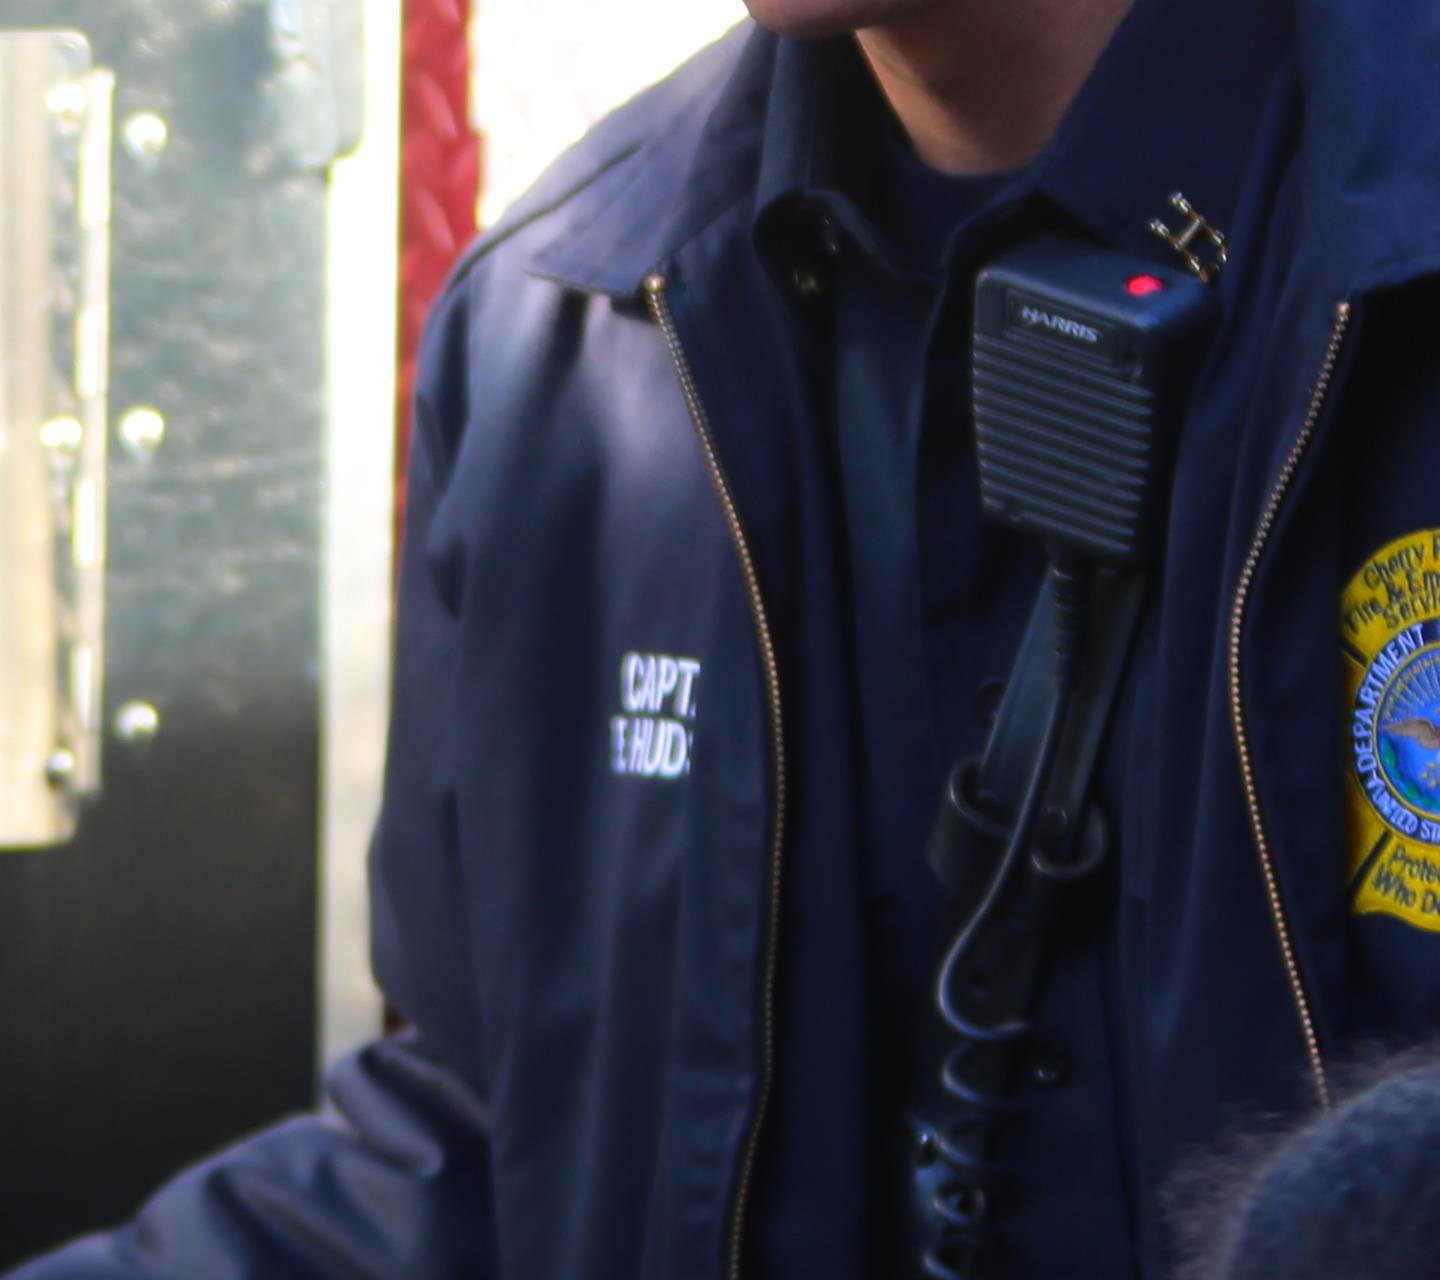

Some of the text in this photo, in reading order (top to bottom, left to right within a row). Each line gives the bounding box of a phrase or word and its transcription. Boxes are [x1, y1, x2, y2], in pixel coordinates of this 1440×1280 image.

[1022, 306, 1100, 343] HARRIS
[1363, 543, 1425, 590] Cherry
[1347, 596, 1384, 634] Fire
[1387, 582, 1405, 604] &
[1352, 623, 1425, 774] DEPARTMENT
[1369, 786, 1419, 835] UNITED
[1373, 863, 1418, 908] Who
